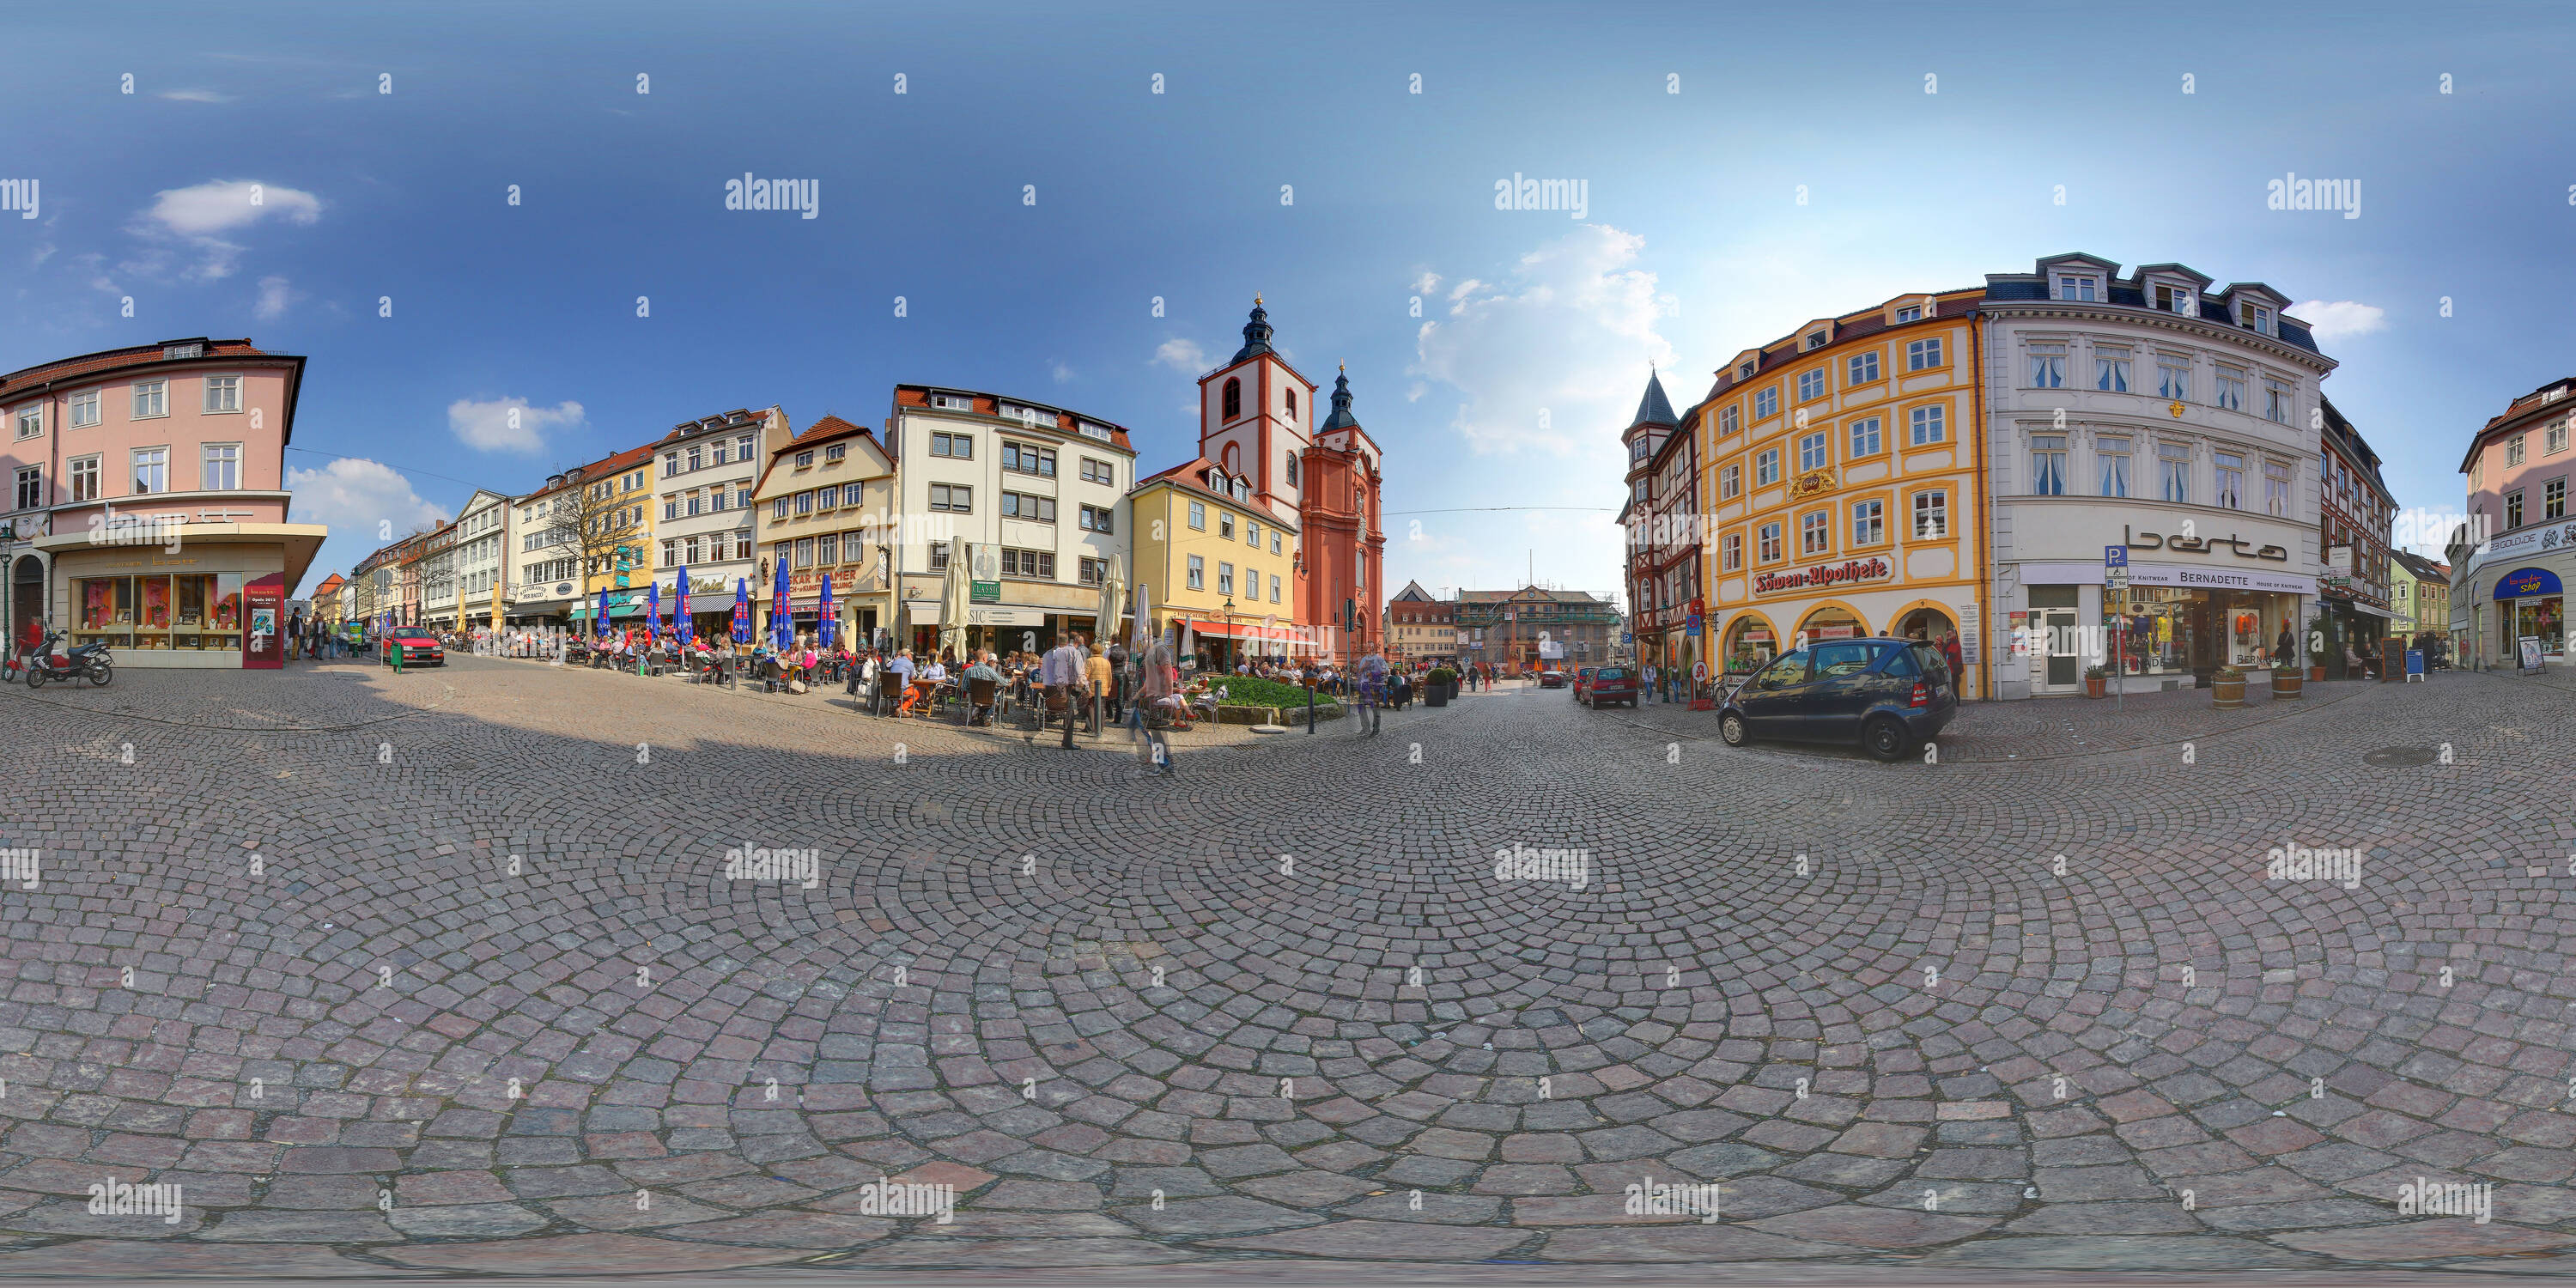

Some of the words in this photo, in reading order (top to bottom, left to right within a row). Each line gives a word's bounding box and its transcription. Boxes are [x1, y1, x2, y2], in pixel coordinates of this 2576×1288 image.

[2108, 548, 2121, 564] P
[789, 574, 811, 586] SKAR
[2180, 572, 2249, 586] BERNADETTE
[520, 586, 547, 596] RISTORANTE
[972, 585, 999, 594] CLASSIC
